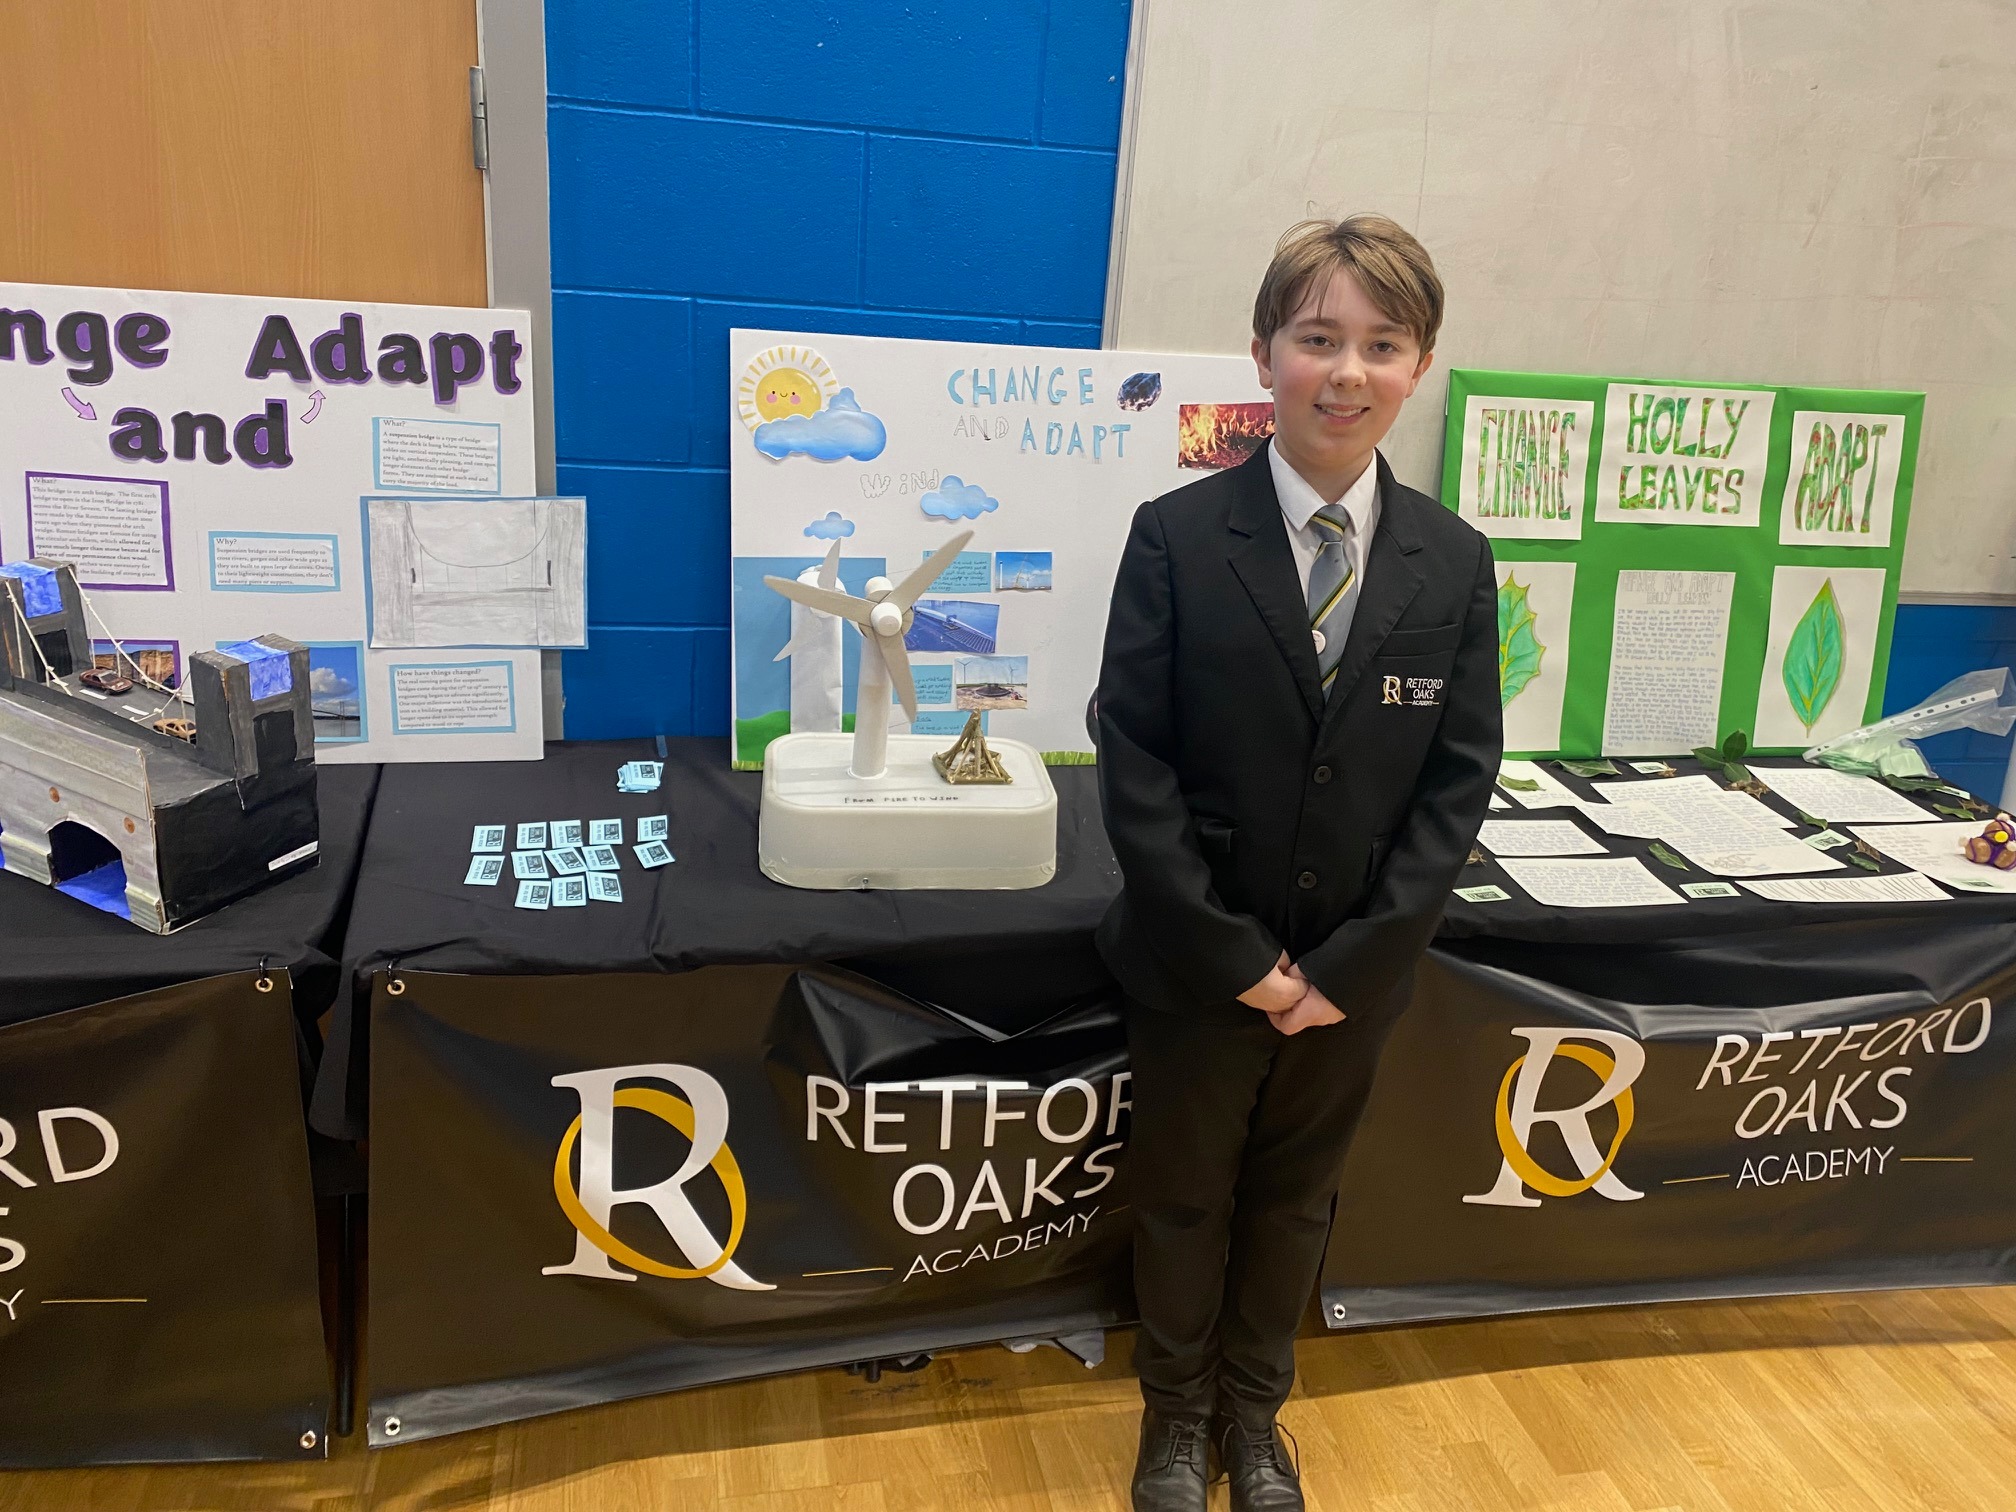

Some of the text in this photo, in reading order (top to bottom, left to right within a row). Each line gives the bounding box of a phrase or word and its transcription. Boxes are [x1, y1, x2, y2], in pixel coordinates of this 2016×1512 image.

[245, 312, 522, 404] Adapt
[947, 366, 1094, 405] CHANGE
[109, 399, 293, 469] and
[953, 414, 1131, 460] AND ADAPT
[1626, 393, 1750, 459] HOLLY
[1478, 408, 1576, 520] CHANGE
[1619, 465, 1745, 514] LEAVES
[1794, 421, 1888, 533] ADAPT
[216, 538, 238, 546] Why?
[1406, 678, 1443, 690] RETFORD
[1412, 688, 1435, 700] OAKS
[1696, 997, 1991, 1090] RETFORD
[1734, 1067, 1914, 1140] OAKS
[892, 1142, 1124, 1236] OAKS
[1736, 1146, 1895, 1190] ACADEMY
[902, 1206, 1100, 1282] ACADEMY
